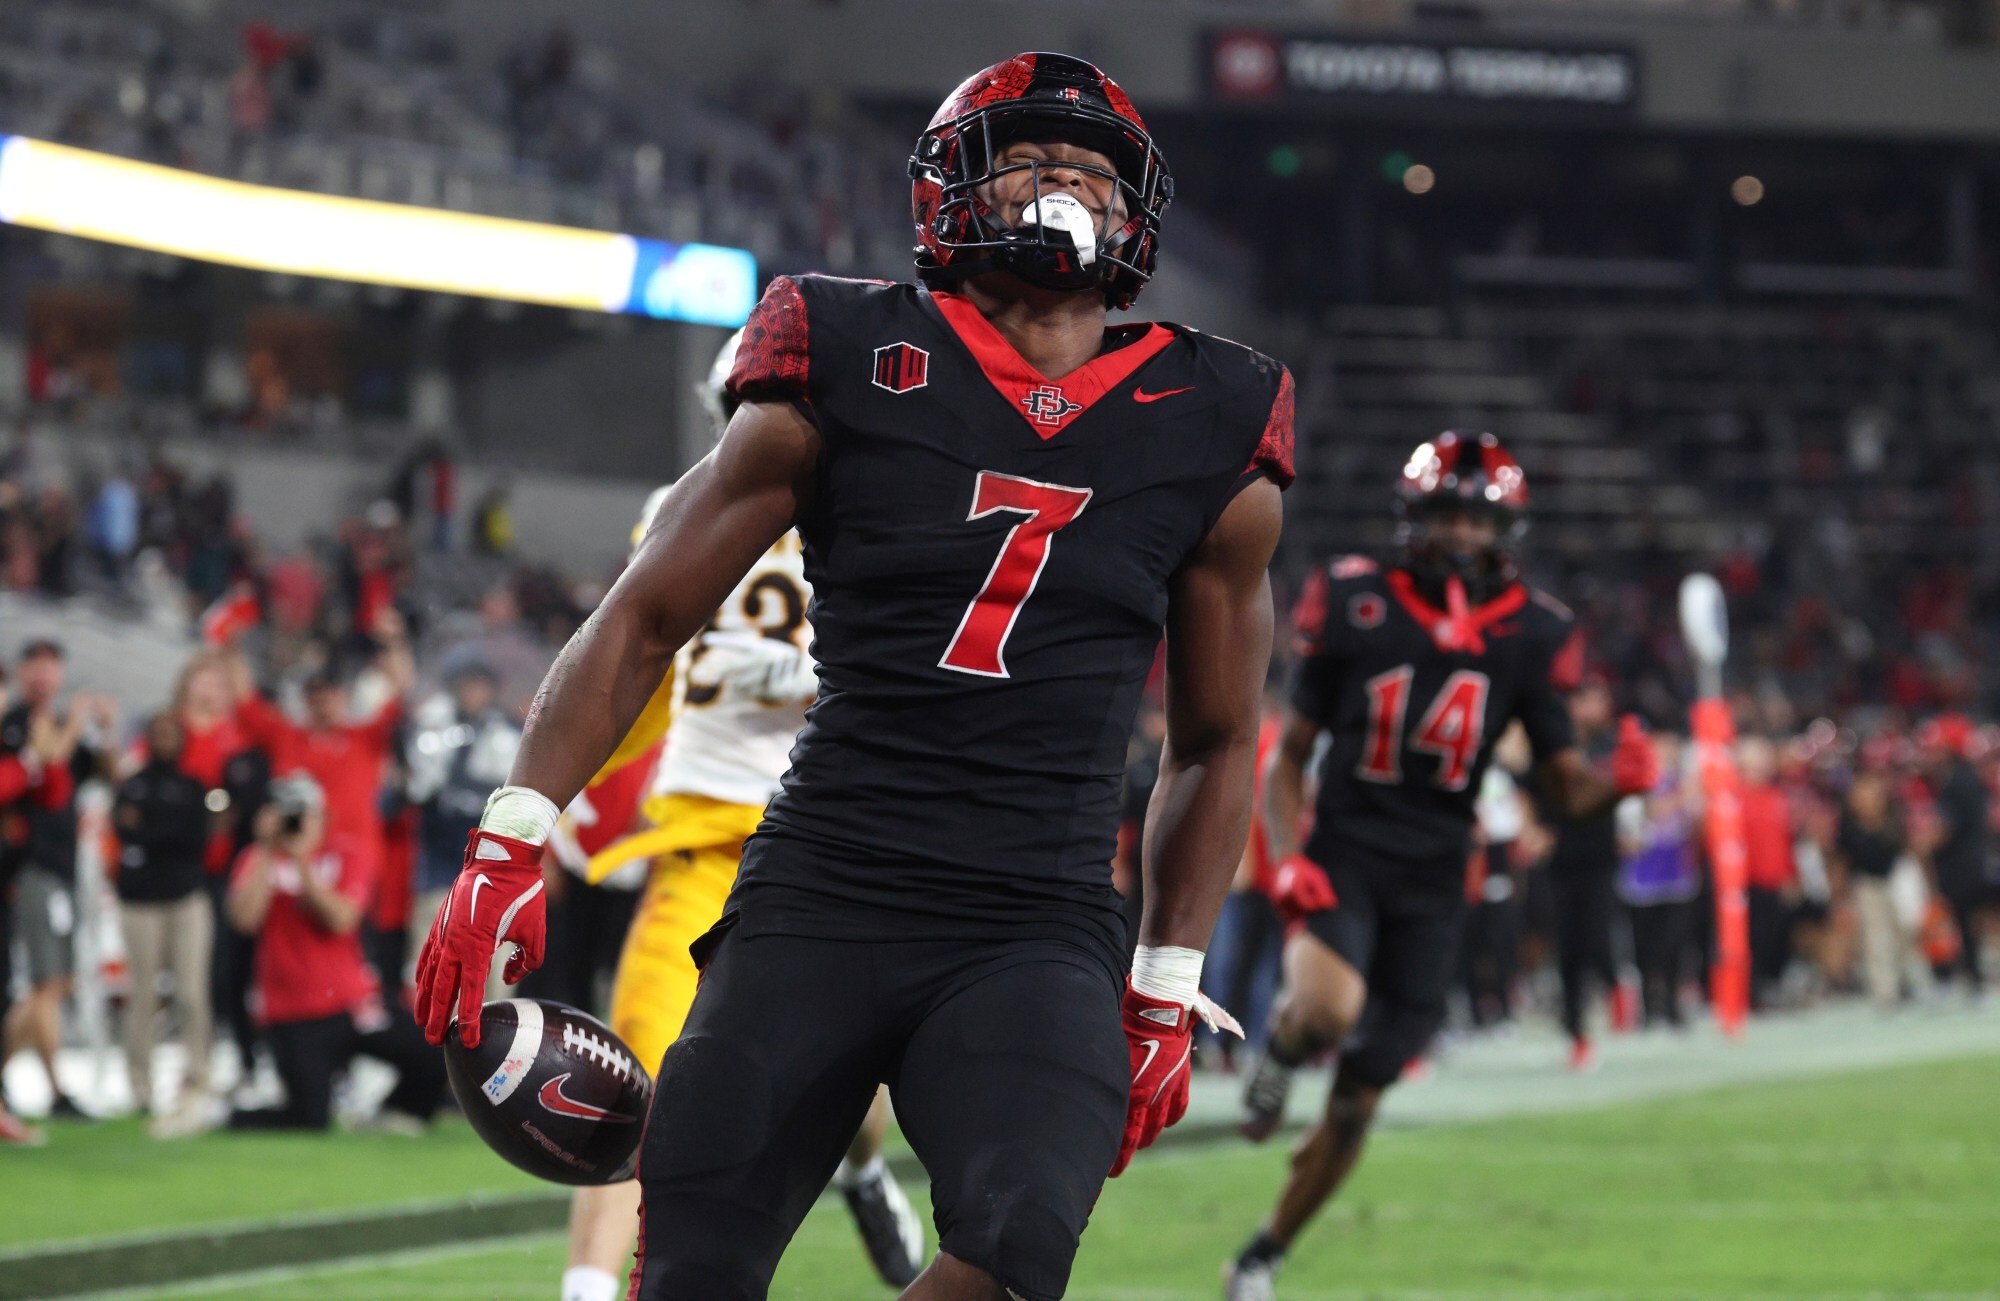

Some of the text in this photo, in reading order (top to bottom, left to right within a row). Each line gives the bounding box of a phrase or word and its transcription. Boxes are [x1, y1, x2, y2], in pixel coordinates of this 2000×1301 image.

[1290, 40, 1445, 92] TOYOTA
[1046, 198, 1076, 207] SHOCK
[937, 469, 1093, 679] 7
[1357, 664, 1491, 792] 14
